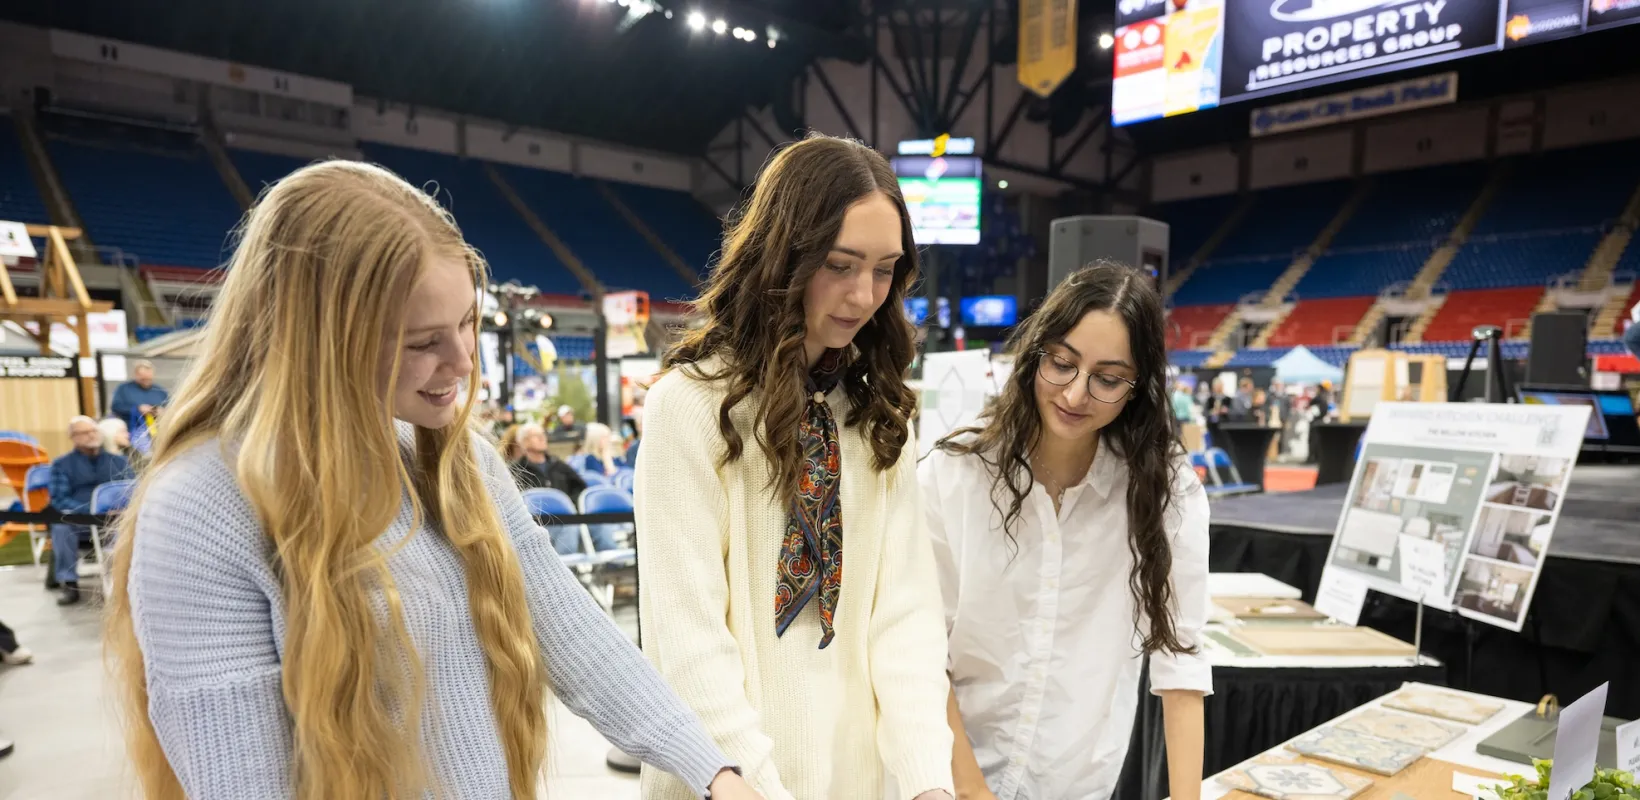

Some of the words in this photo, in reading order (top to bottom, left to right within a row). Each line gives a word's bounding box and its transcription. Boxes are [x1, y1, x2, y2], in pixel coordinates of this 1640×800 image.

[1255, 41, 1377, 81] RESOURCES
[1382, 23, 1462, 54] GROUP
[1262, 0, 1447, 62] PROPERTY
